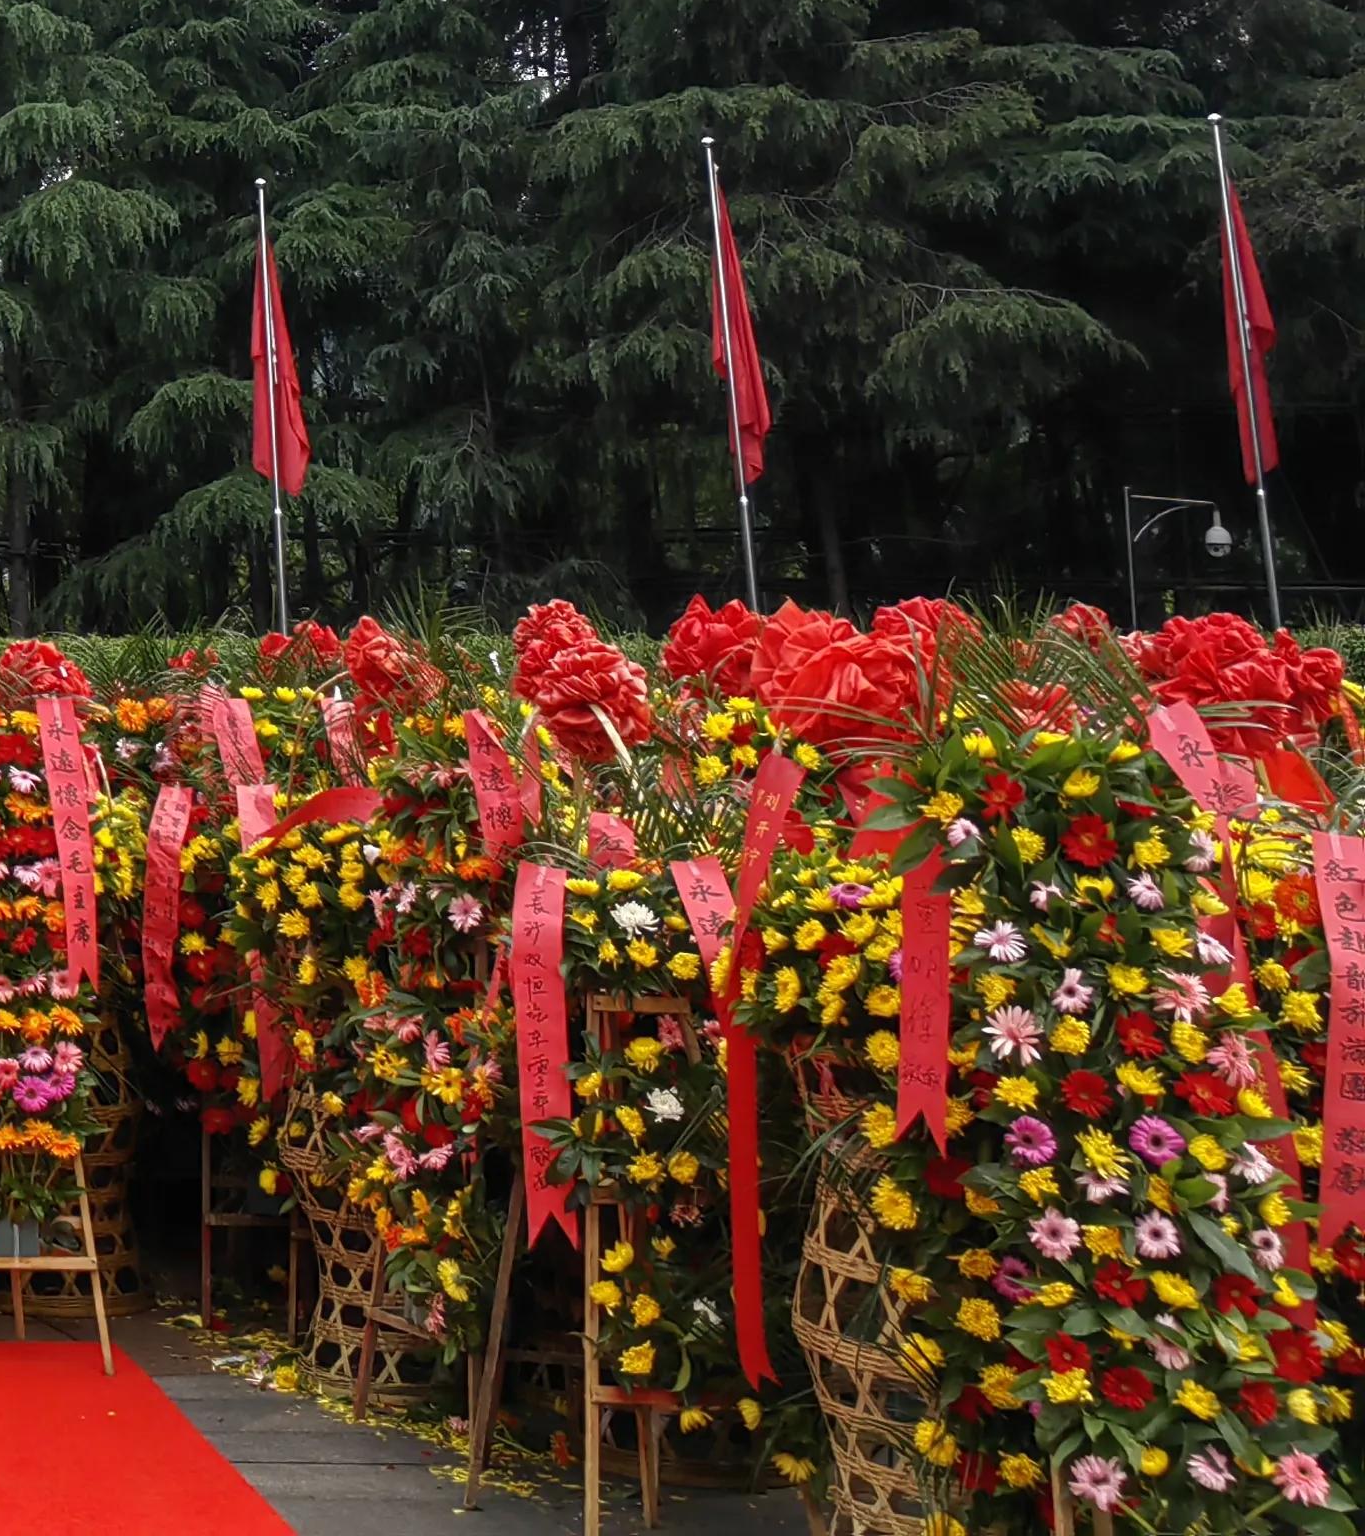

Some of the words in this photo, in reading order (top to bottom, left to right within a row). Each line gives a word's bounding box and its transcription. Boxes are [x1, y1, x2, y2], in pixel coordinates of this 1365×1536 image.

[47, 721, 91, 948] 永遠懷念毛主席
